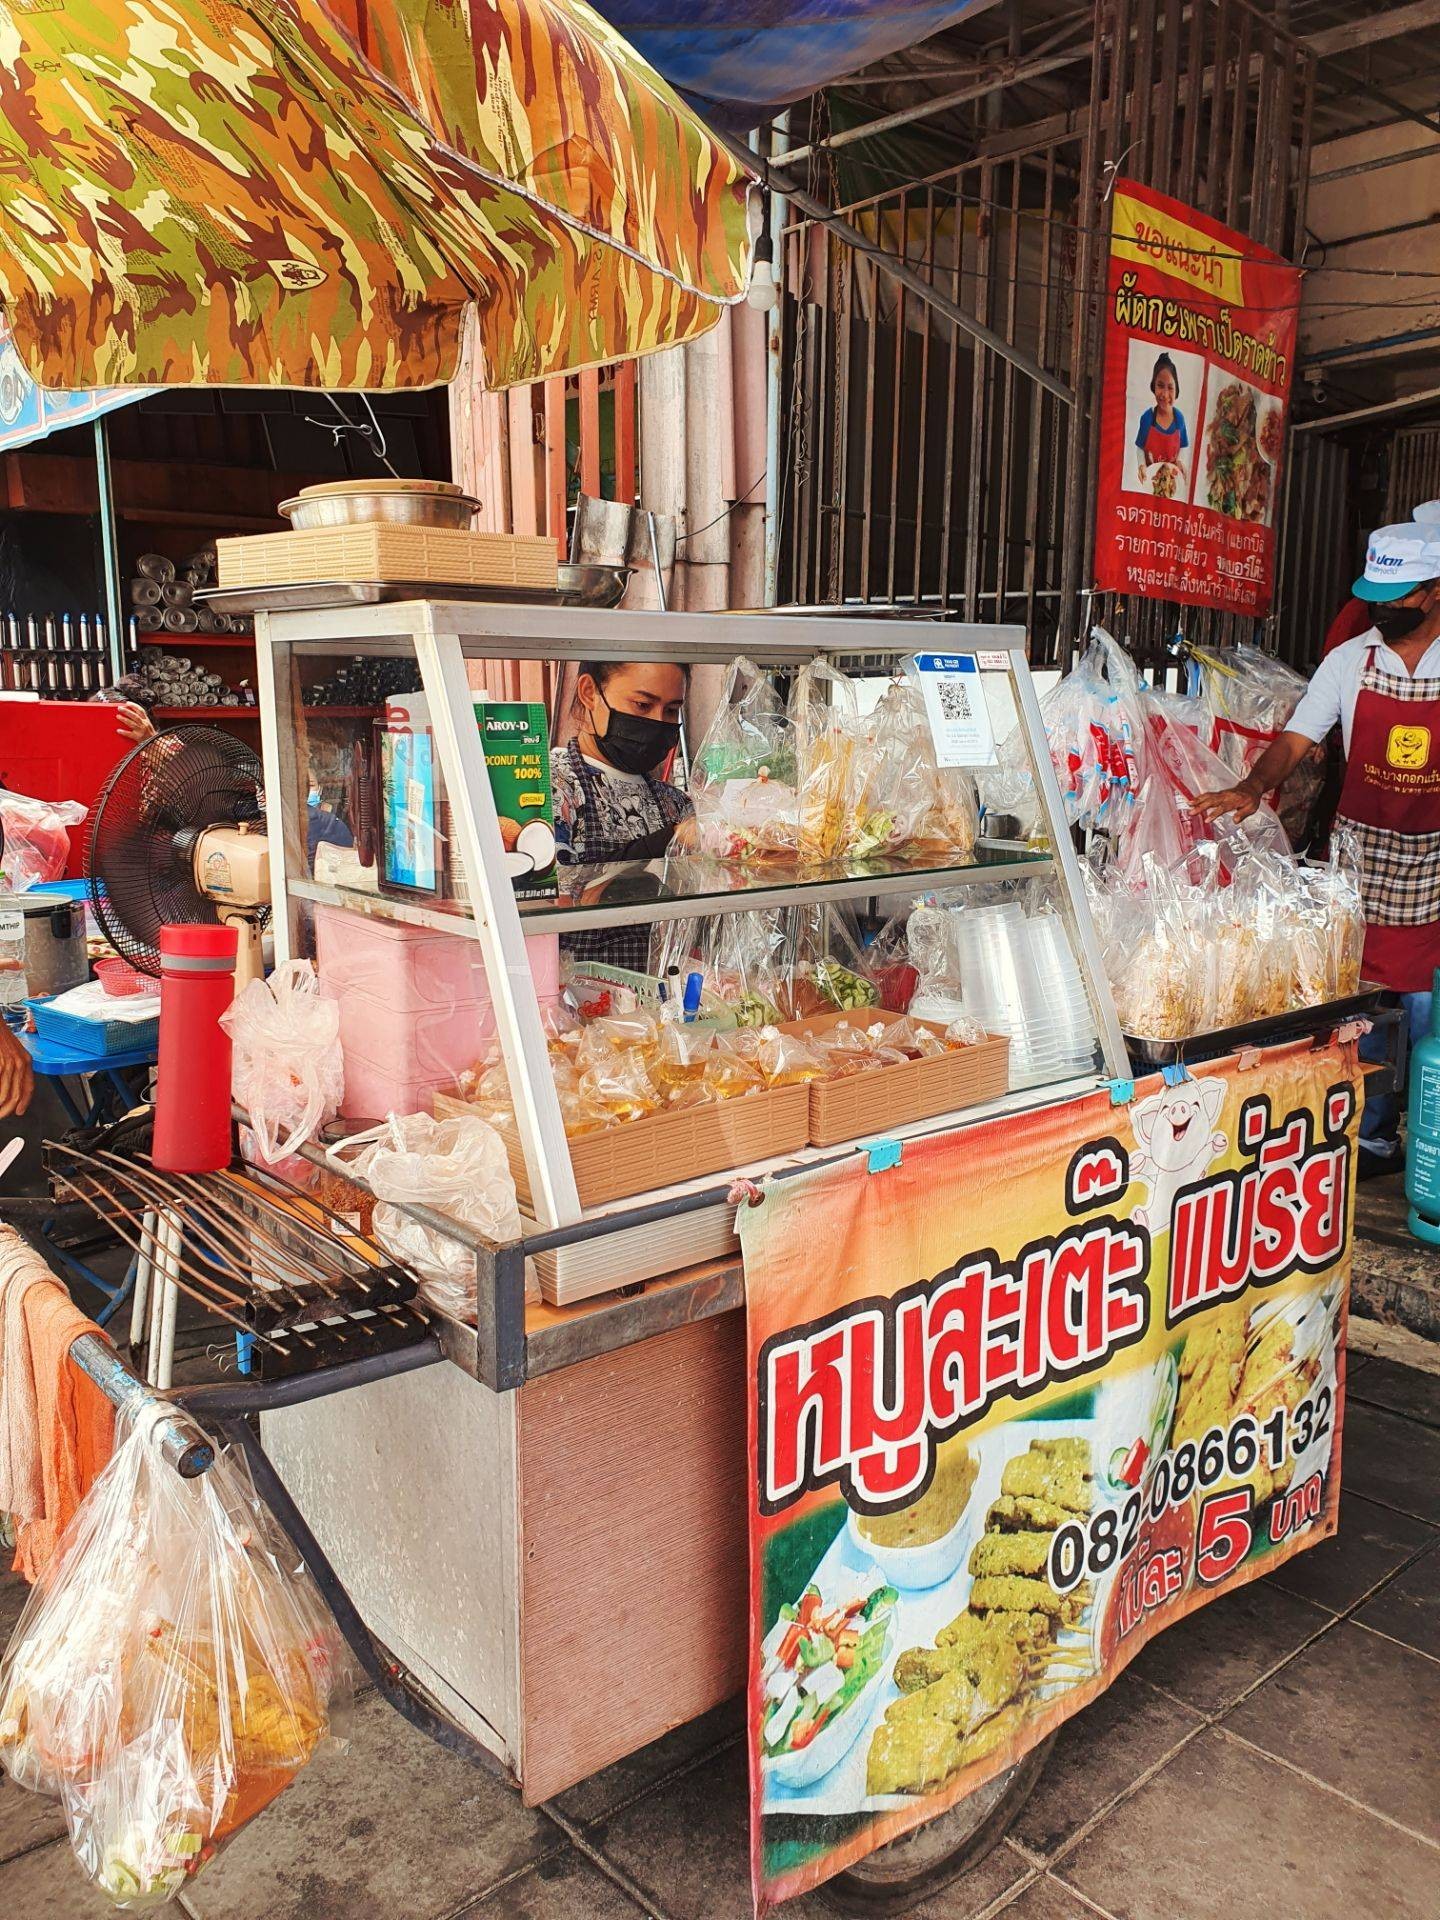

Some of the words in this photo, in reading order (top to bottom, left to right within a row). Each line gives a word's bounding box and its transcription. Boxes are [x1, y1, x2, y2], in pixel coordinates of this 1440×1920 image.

[1135, 221, 1223, 289] ขอแนะนำ
[486, 721, 529, 731] AROY-D
[484, 755, 518, 766] OCONUT
[521, 754, 541, 765] MILK
[514, 767, 542, 779] 100%
[763, 1144, 1146, 1508] หมูสะเต๊ะ
[1196, 1487, 1254, 1586] 5
[1270, 1472, 1323, 1544] บาท
